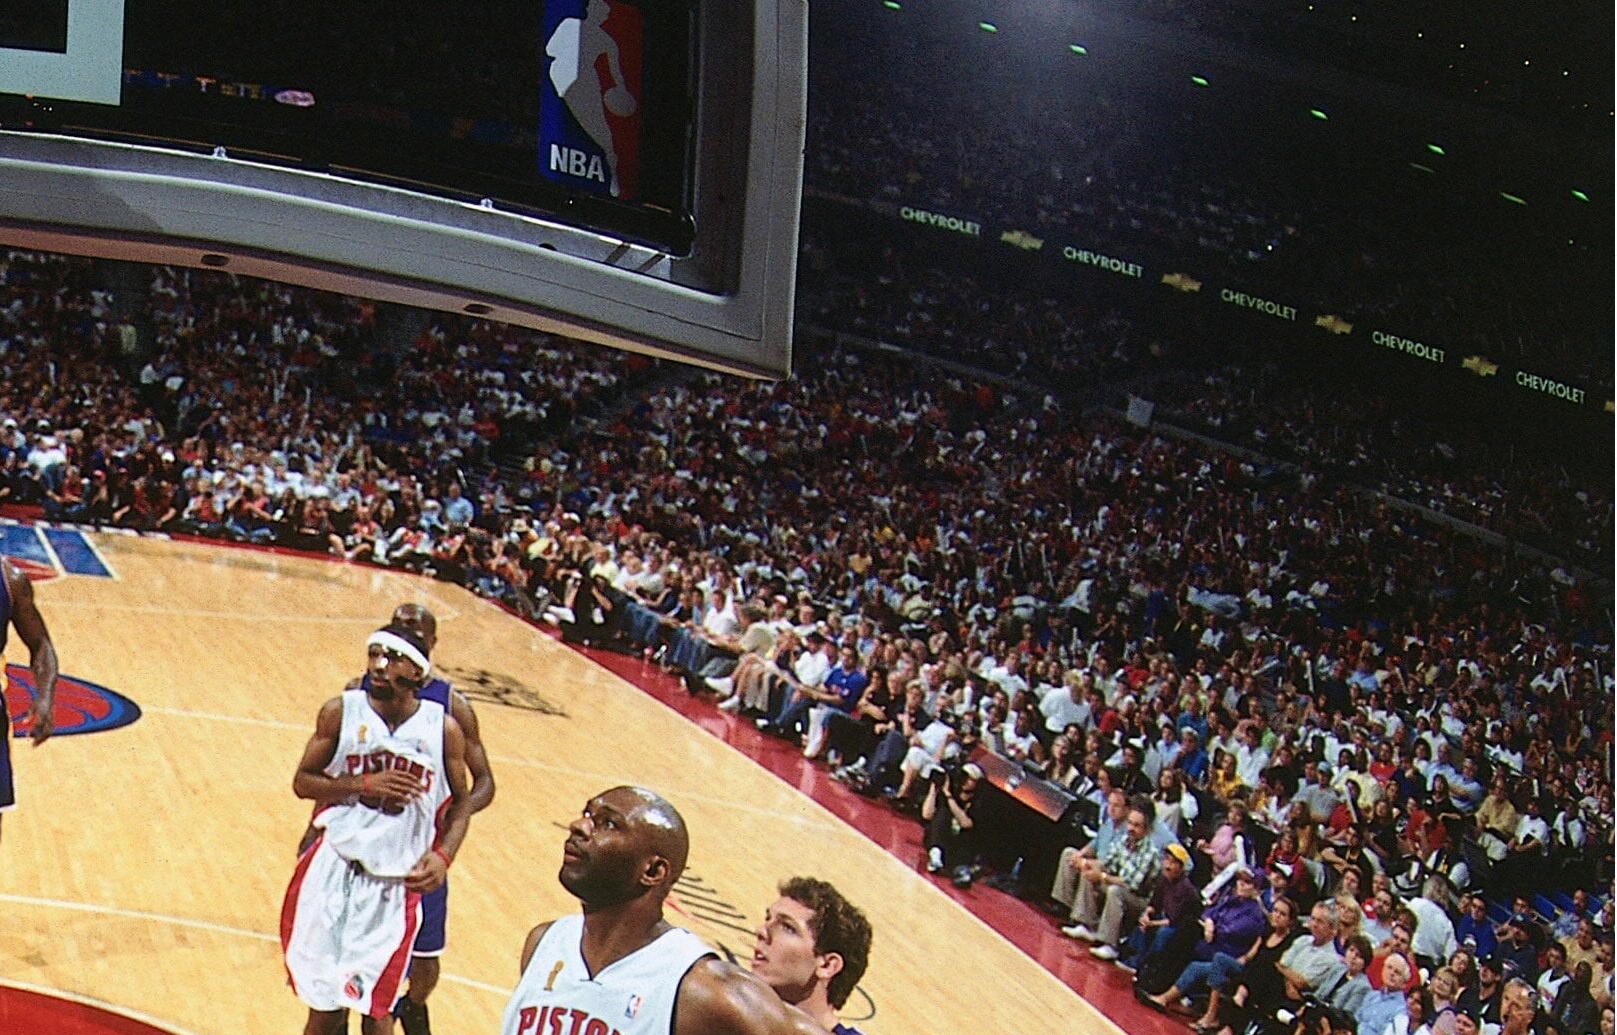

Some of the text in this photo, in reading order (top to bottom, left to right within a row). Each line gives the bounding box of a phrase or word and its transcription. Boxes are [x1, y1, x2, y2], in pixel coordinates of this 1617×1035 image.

[550, 143, 605, 183] NBA
[900, 206, 981, 236] CHEVROLET
[1063, 246, 1143, 279] CHEVROLET
[1221, 289, 1297, 321] CHEVROLET
[1372, 331, 1445, 363] CHEVROLET
[1516, 371, 1585, 405] CHEVROLET
